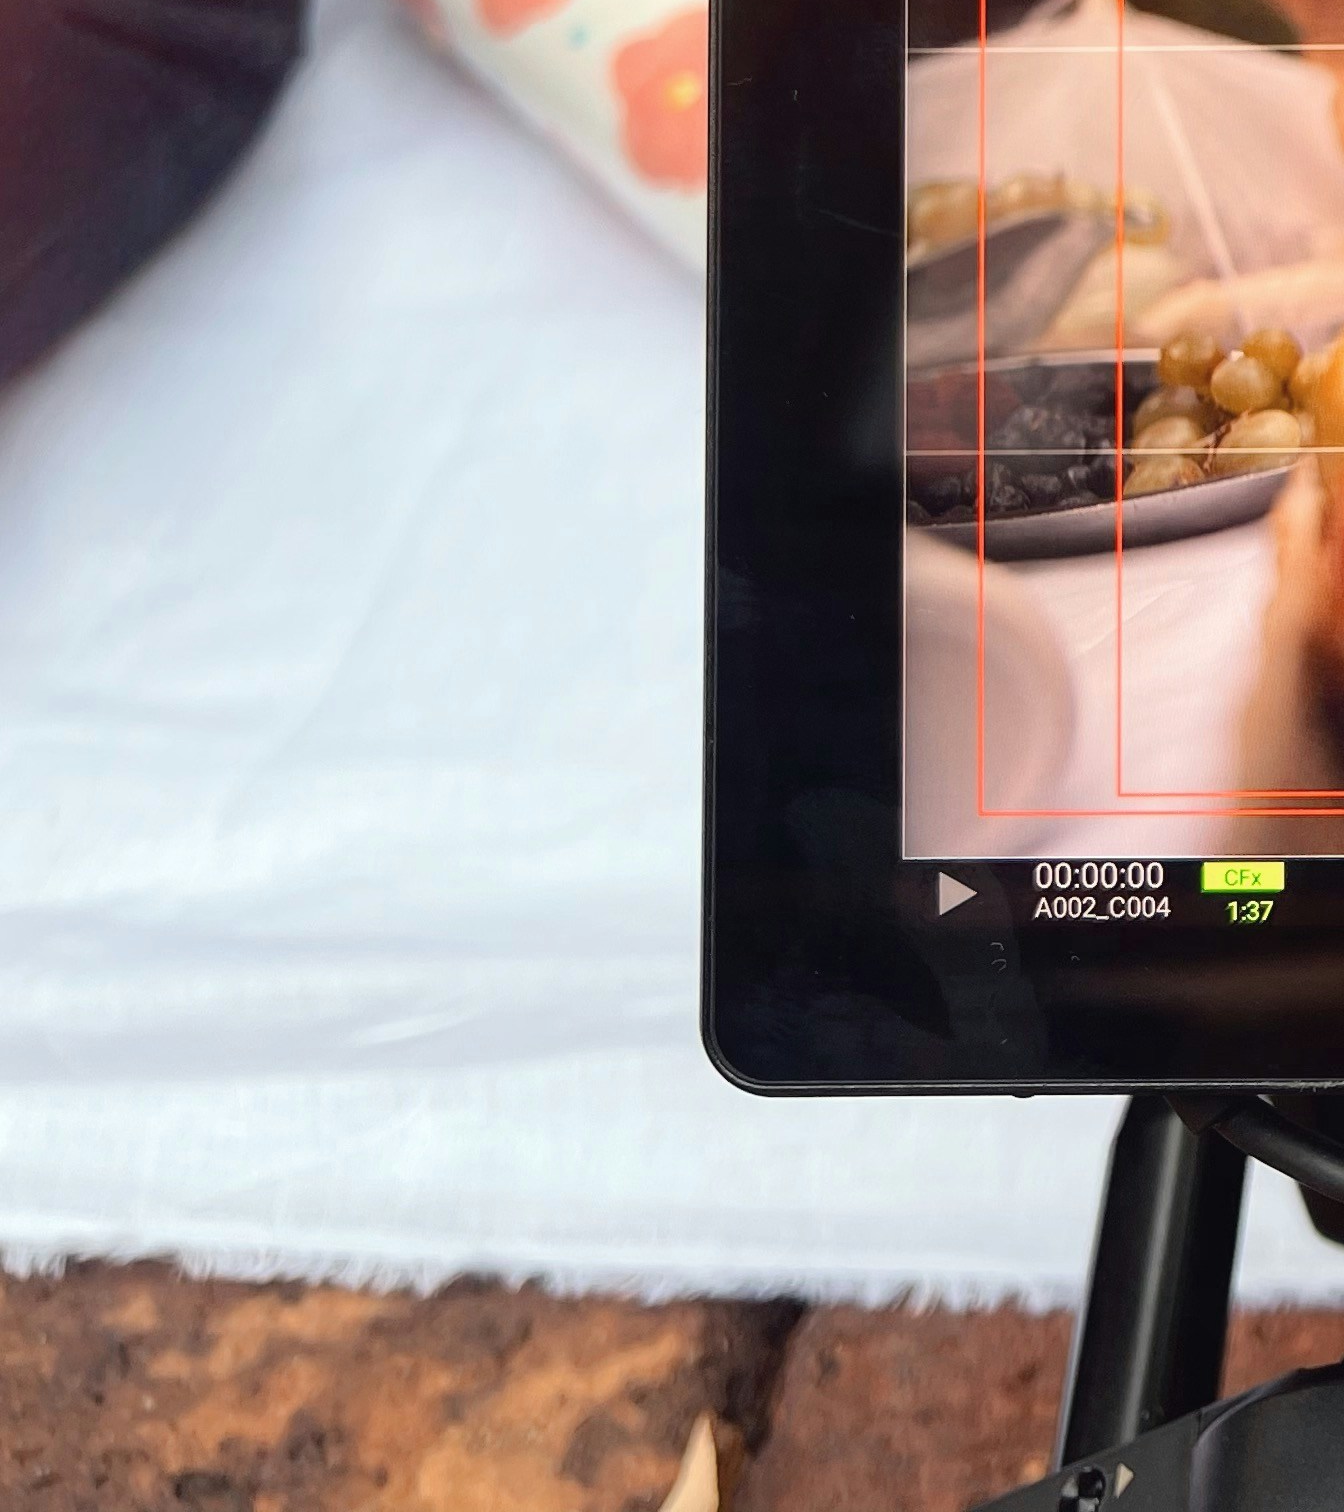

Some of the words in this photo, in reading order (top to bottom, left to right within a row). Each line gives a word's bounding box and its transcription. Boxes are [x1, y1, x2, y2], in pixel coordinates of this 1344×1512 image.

[1033, 861, 1165, 890] 00:00:00
[1223, 868, 1263, 887] CFx
[1033, 895, 1172, 923] A002_C004
[1226, 900, 1275, 923] 1:37
